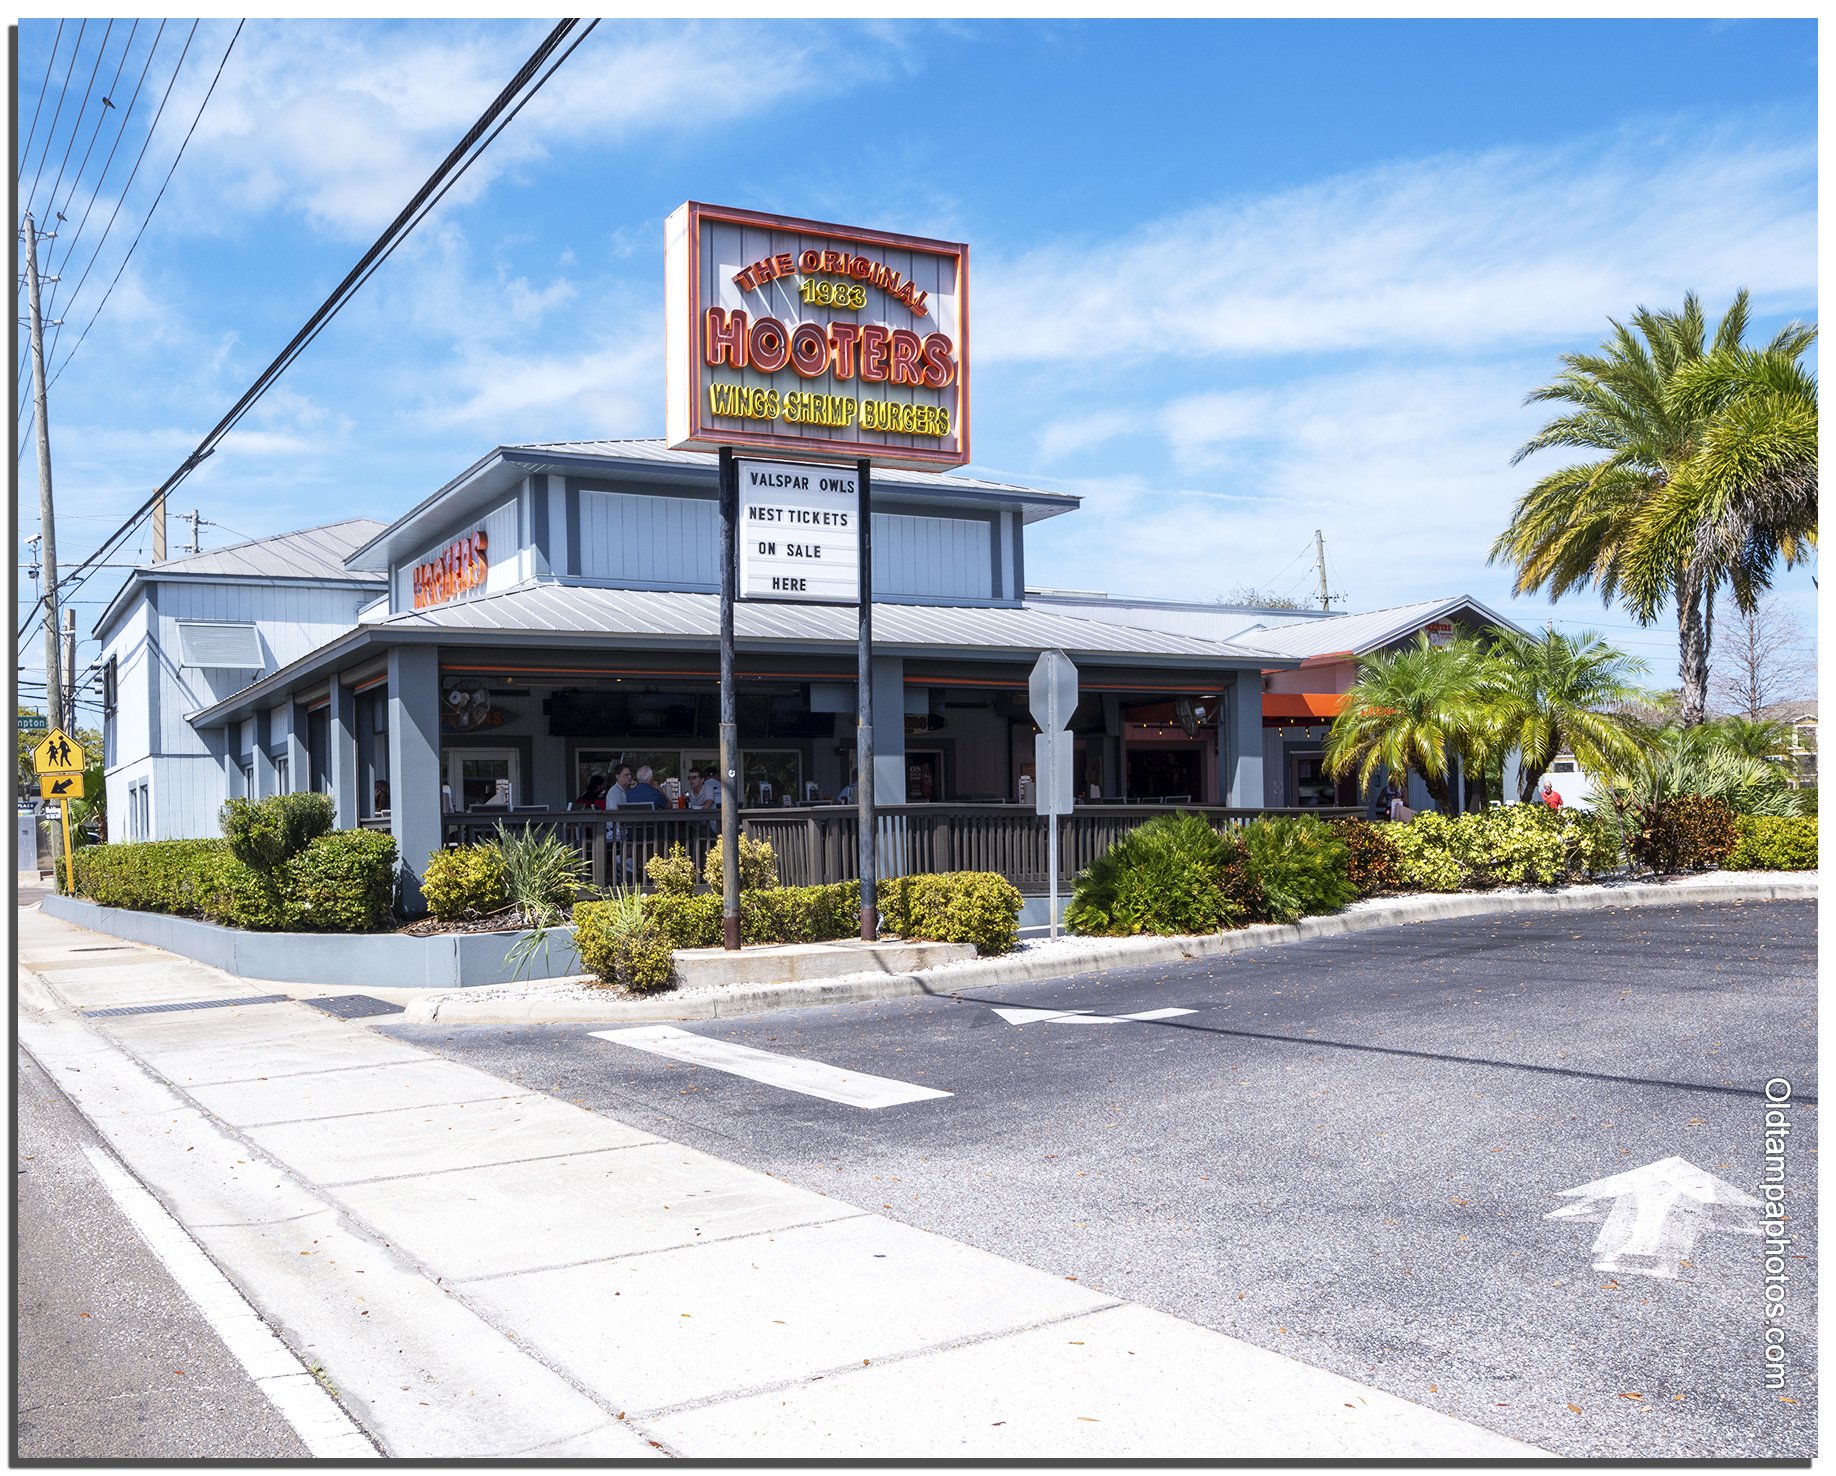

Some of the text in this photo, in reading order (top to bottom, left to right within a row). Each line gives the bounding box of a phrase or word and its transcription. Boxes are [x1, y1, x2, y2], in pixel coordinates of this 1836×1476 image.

[732, 249, 929, 317] THE ORIGINAL
[800, 279, 867, 310] 1983
[705, 307, 954, 388] HOOTERS
[710, 383, 950, 437] WINGS SHRIMP BURGERS
[750, 472, 855, 493] VALSPAR OWLS
[749, 506, 848, 526] NEST TICKETS
[758, 541, 821, 558] ON SALE
[413, 531, 488, 609] HOOTERS
[772, 576, 807, 591] HERE
